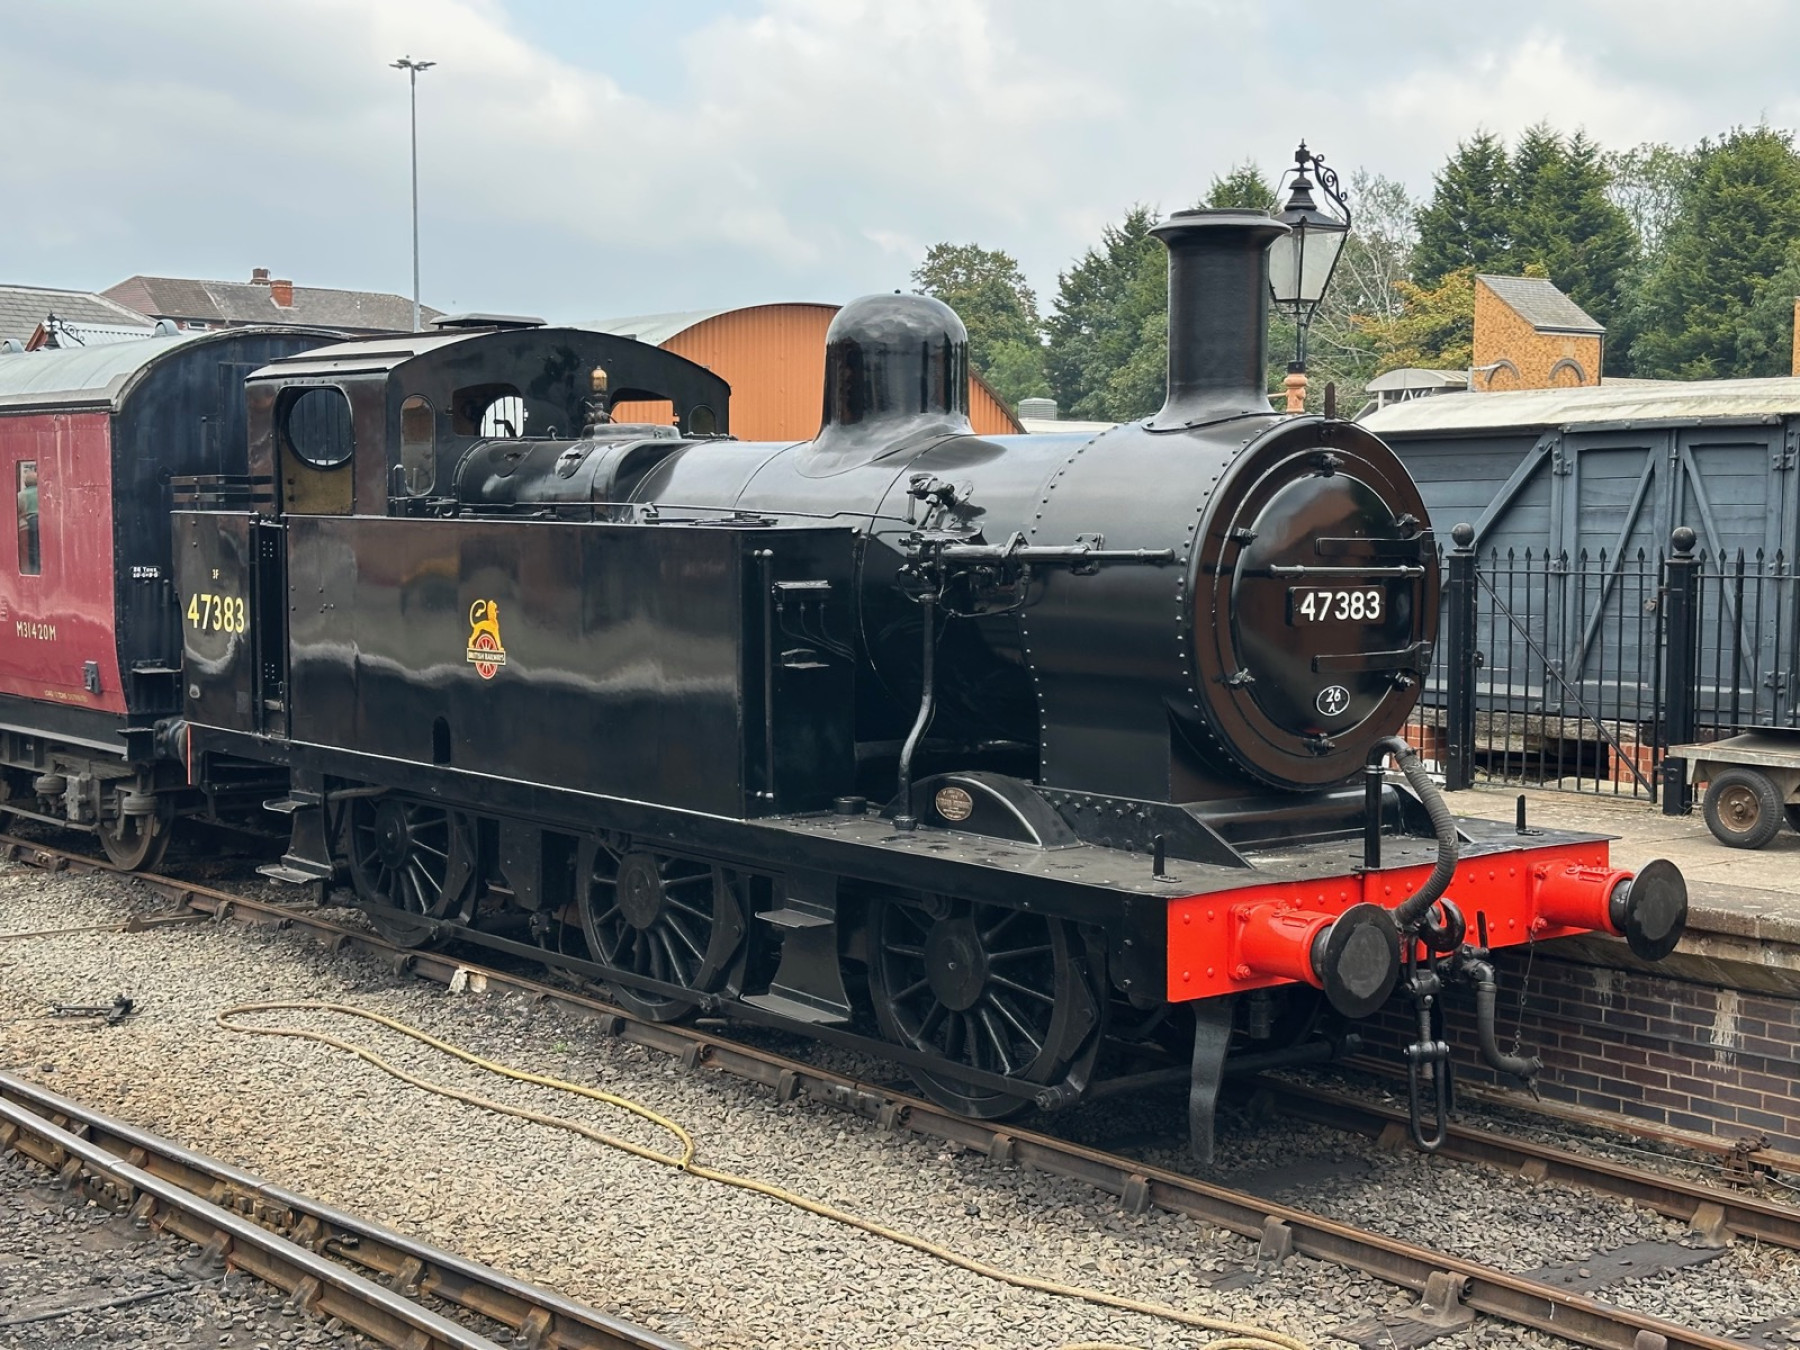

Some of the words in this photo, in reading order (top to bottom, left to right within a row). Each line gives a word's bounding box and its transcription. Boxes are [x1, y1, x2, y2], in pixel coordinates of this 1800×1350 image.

[188, 593, 245, 633] 47383
[1300, 591, 1380, 621] 47383
[16, 620, 57, 641] M31420M
[1326, 689, 1341, 703] 26
[1328, 703, 1336, 713] A
